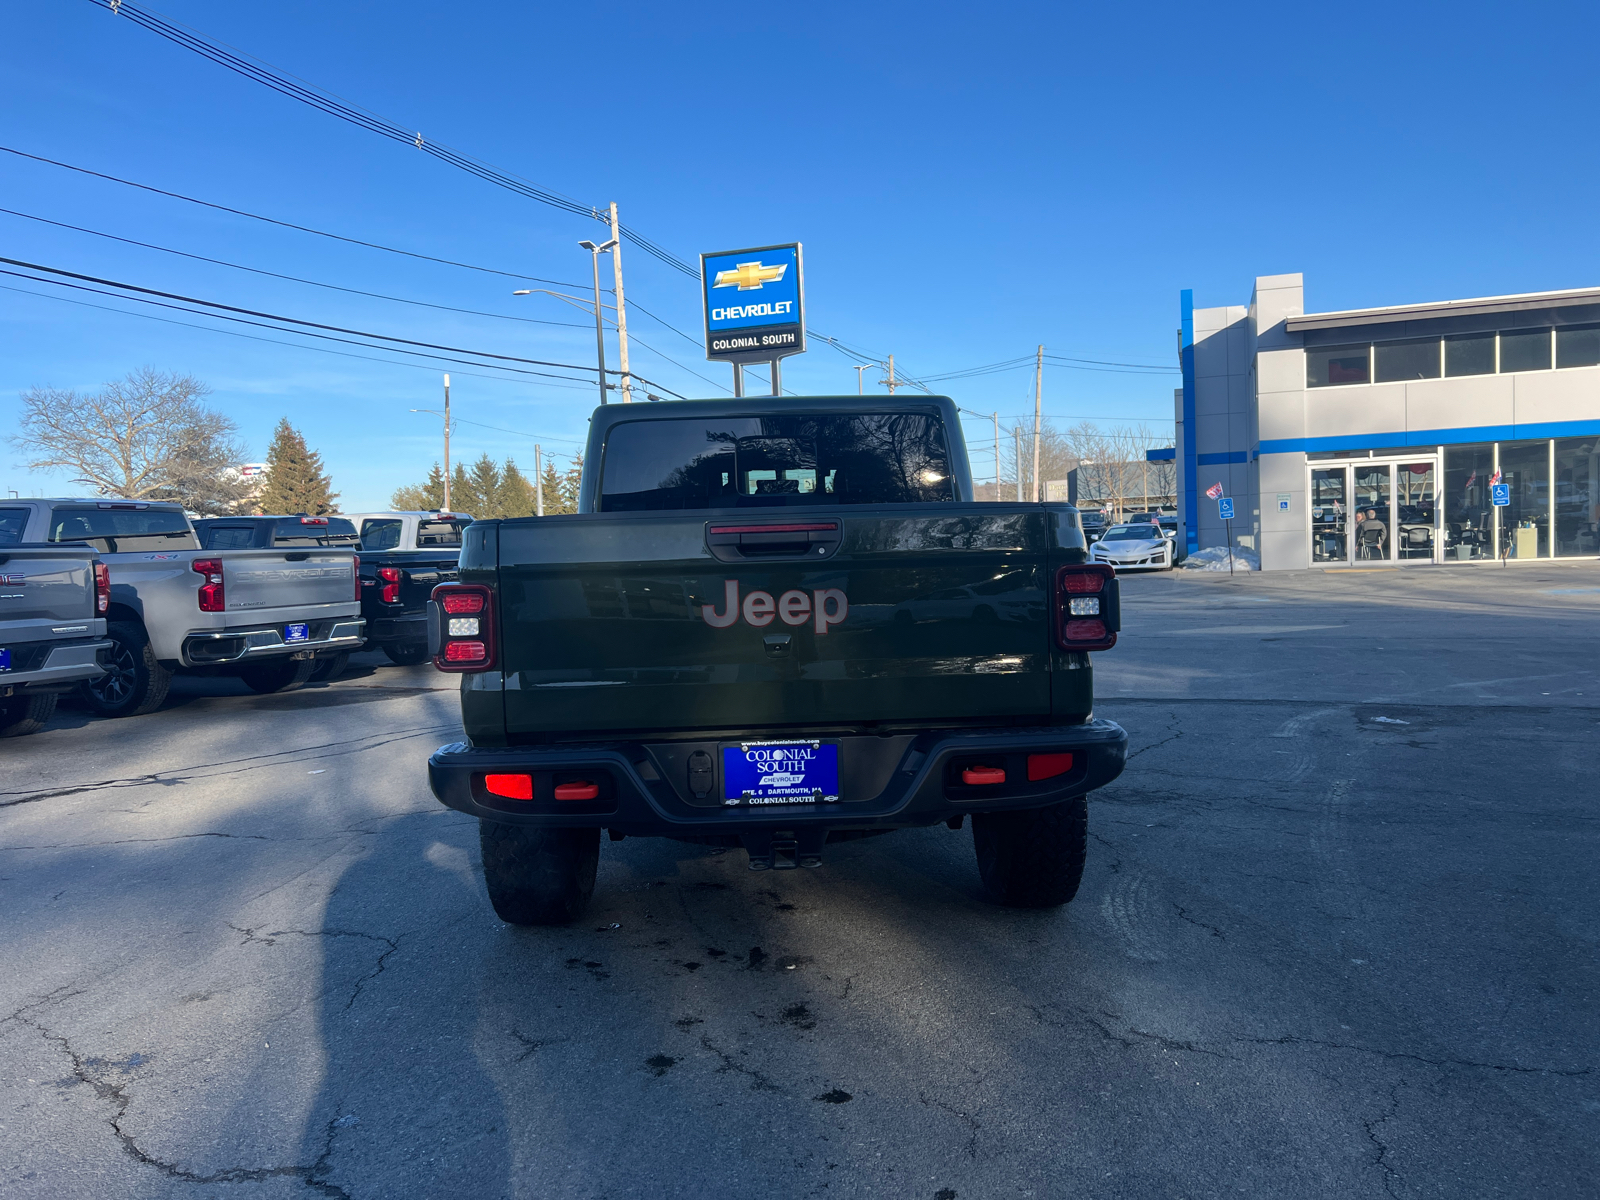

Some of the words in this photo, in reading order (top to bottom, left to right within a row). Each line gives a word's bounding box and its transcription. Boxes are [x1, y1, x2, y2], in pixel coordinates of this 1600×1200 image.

[712, 301, 792, 321] CHEVROLET
[713, 337, 759, 350] COLONIAL
[762, 333, 795, 345] SOUTH
[236, 567, 351, 583] CHEVROLET
[702, 579, 849, 635] Jeep
[746, 749, 816, 762] COLONIAL
[757, 761, 805, 773] SOUTH
[749, 797, 788, 805] COLONIAL
[789, 796, 815, 804] SOUTH
